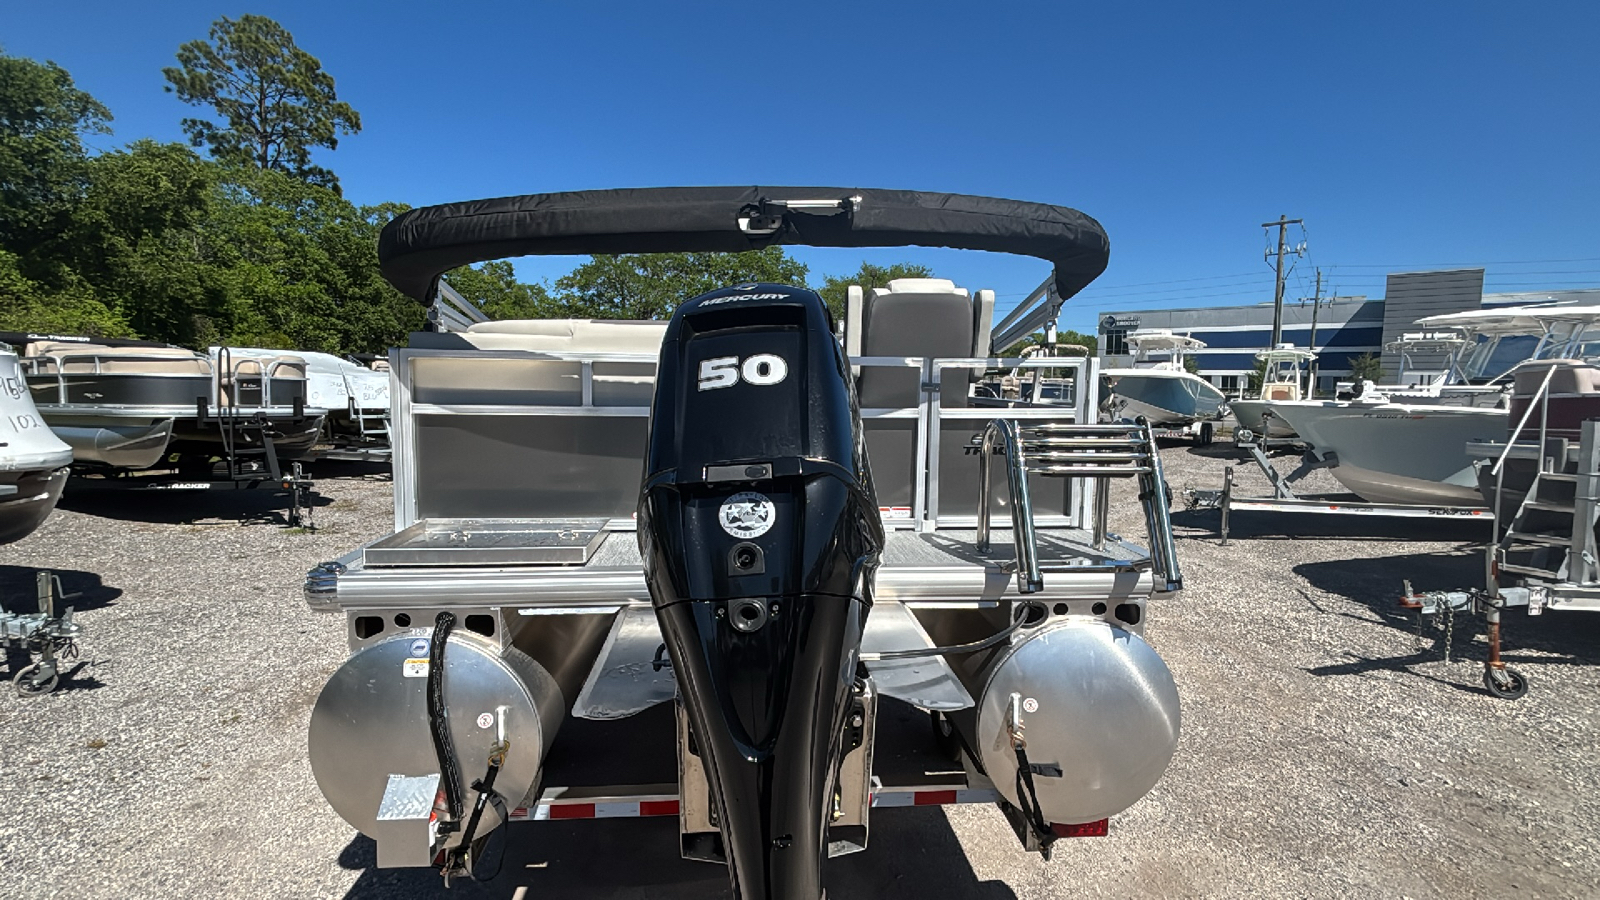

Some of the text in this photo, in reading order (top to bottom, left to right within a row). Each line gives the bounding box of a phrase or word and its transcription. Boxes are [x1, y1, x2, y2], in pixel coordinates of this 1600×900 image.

[698, 293, 790, 308] MERCURY
[48, 334, 91, 342] TRACKER
[698, 353, 788, 392] 50
[8, 414, 42, 433] 102
